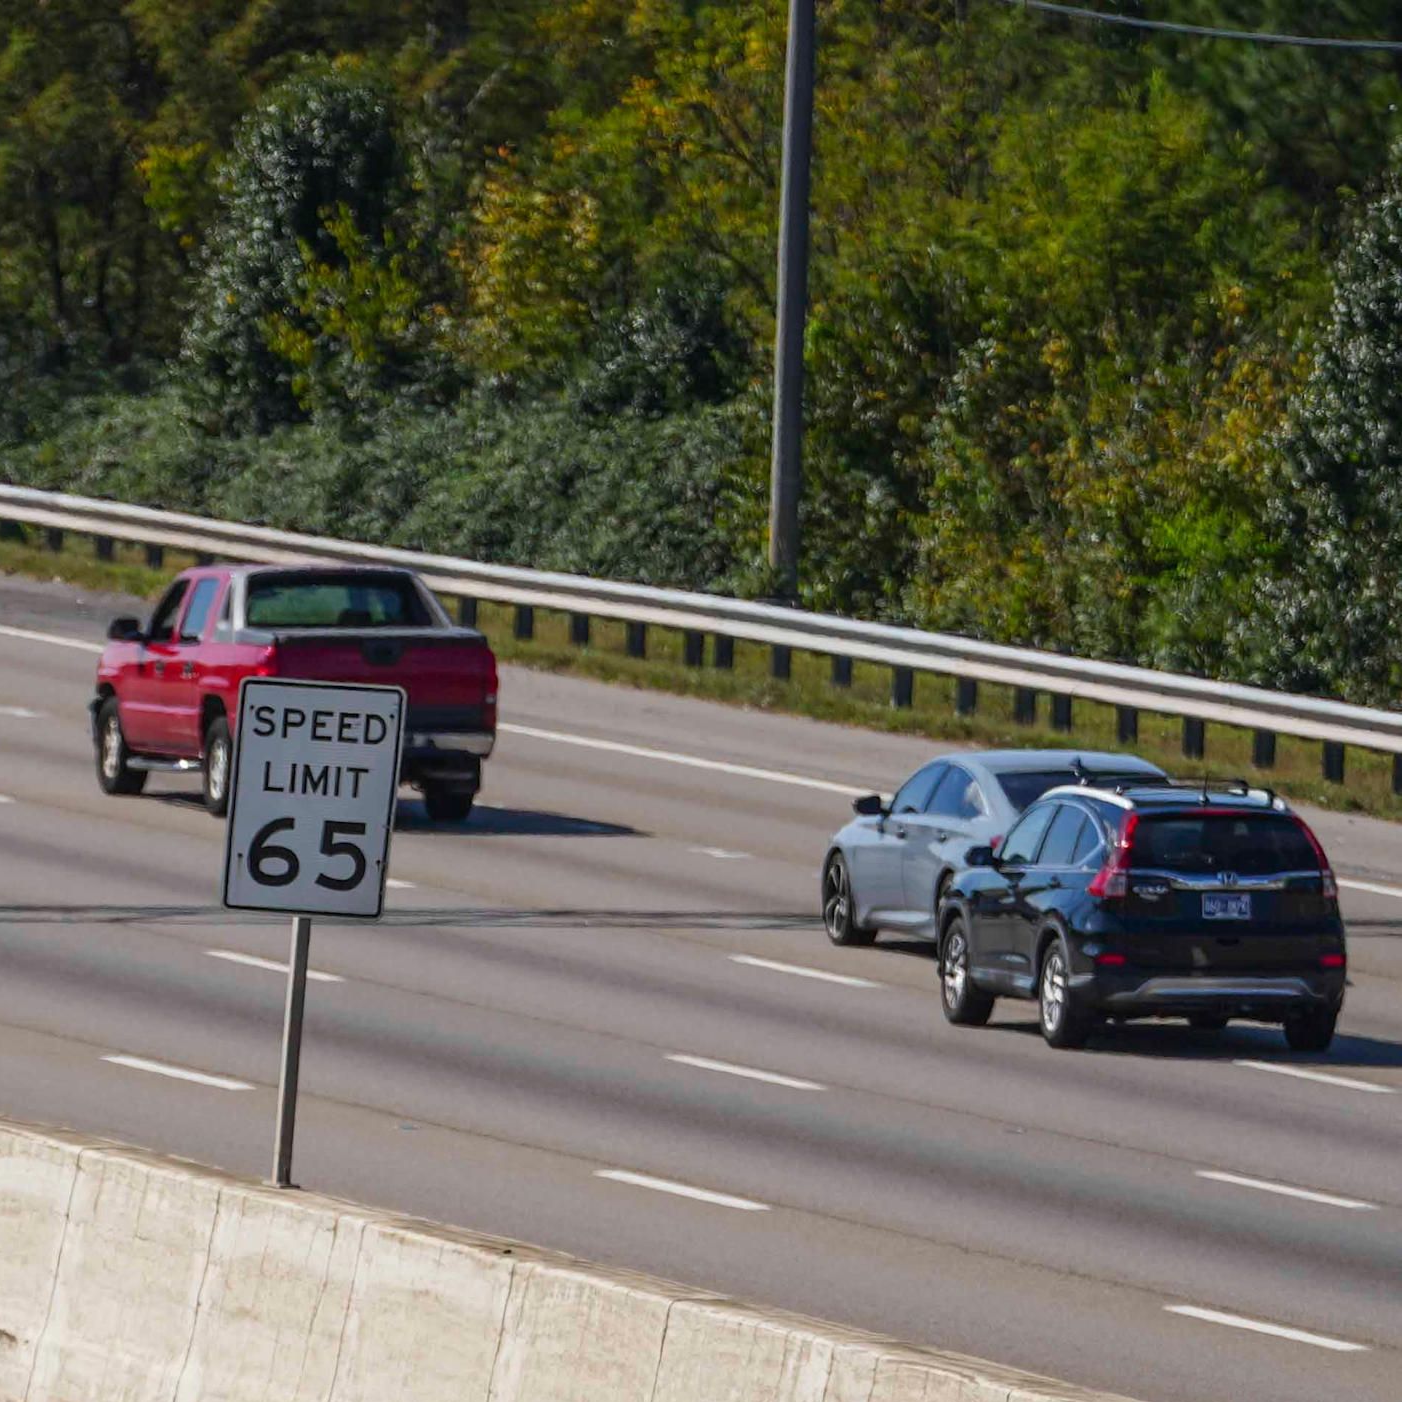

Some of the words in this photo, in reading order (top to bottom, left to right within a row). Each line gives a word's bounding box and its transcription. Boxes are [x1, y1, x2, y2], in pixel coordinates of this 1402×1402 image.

[253, 706, 387, 744] SPEED
[263, 761, 369, 799] LIMIT
[247, 818, 367, 891] 65
